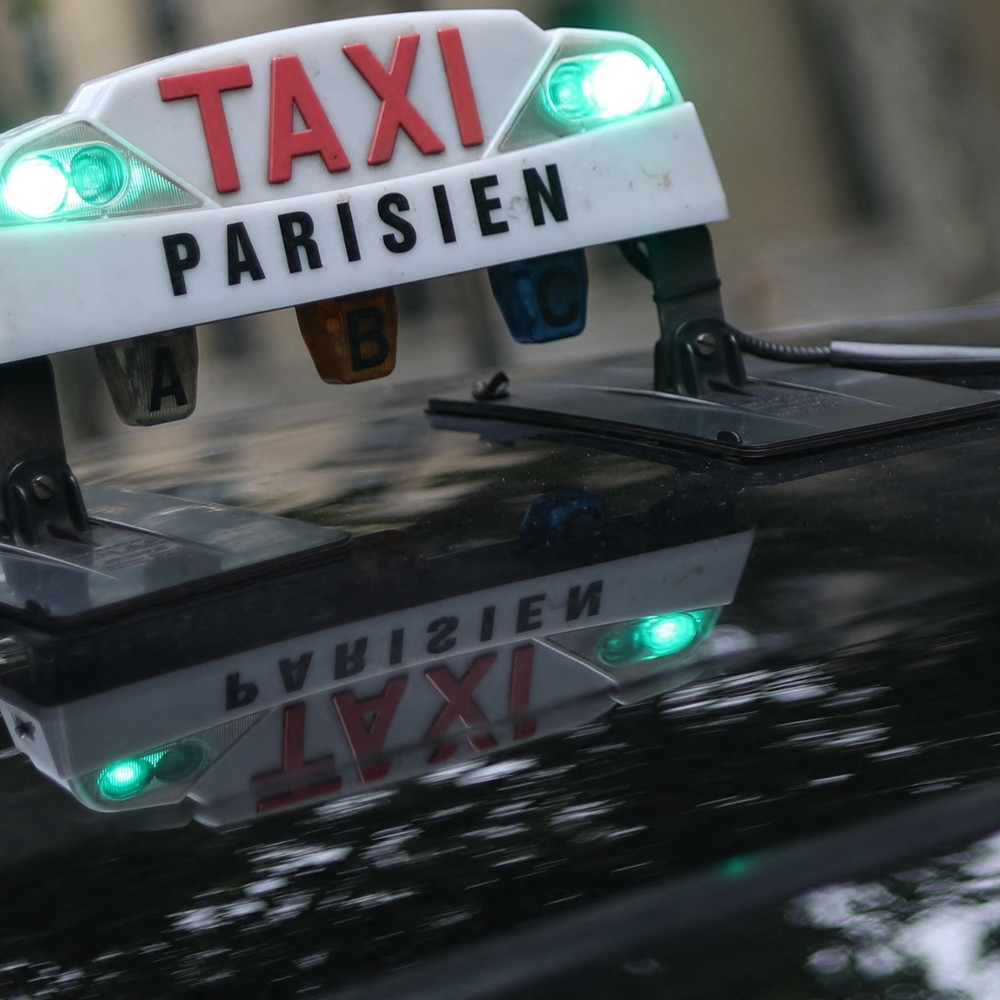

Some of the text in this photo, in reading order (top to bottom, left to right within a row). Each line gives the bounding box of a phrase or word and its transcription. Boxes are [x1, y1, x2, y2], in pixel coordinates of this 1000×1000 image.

[158, 28, 484, 194] TAXI
[162, 164, 569, 296] PARISIEN
[536, 266, 580, 328] C
[346, 307, 389, 371] B
[149, 347, 188, 412] A
